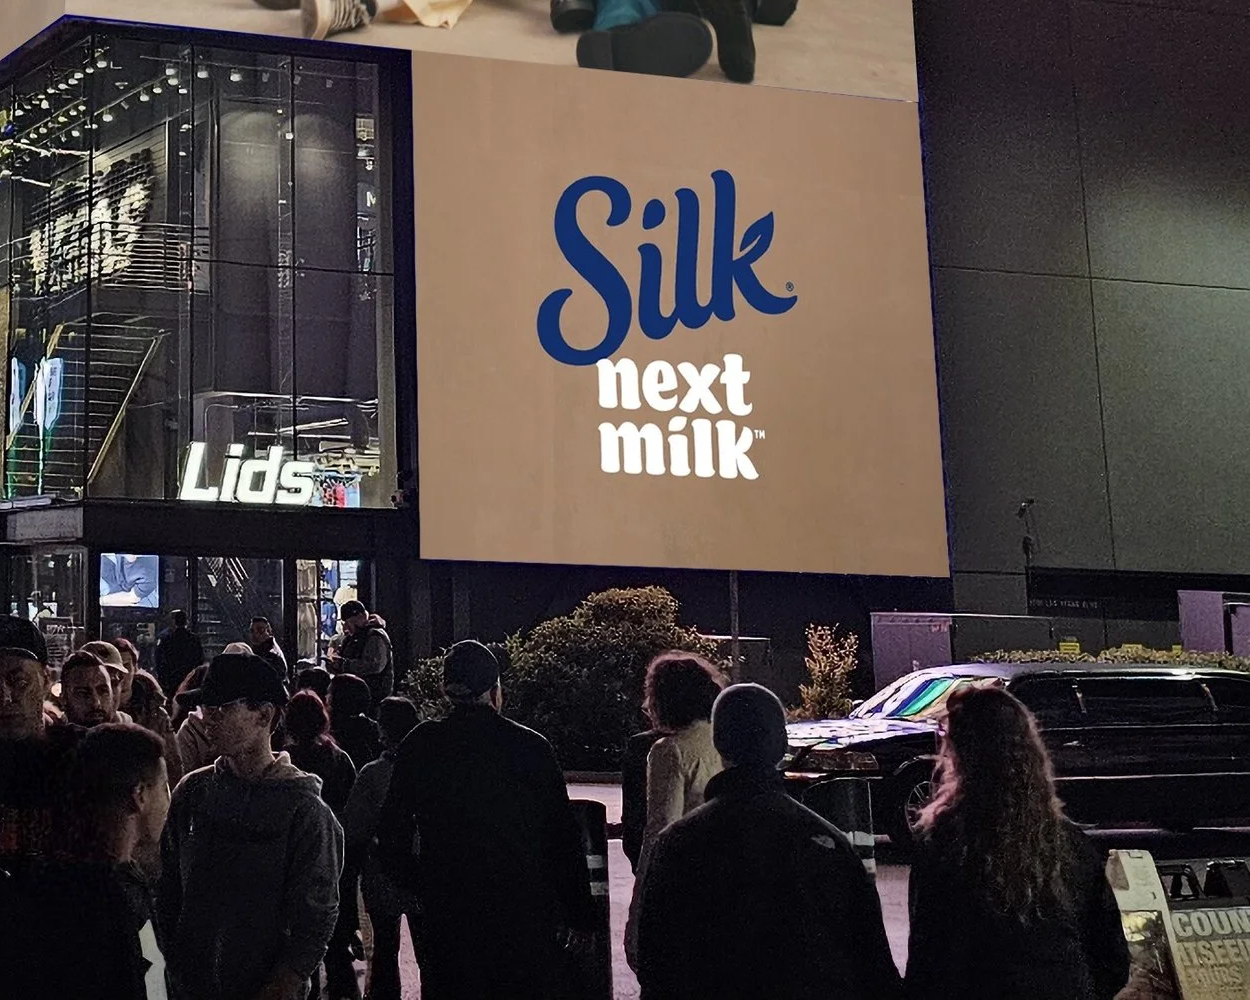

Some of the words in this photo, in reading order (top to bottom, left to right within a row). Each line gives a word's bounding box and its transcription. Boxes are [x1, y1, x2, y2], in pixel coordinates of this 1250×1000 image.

[536, 169, 798, 366] Silk
[596, 353, 753, 416] next
[179, 442, 315, 503] Lids
[598, 416, 759, 480] milk
